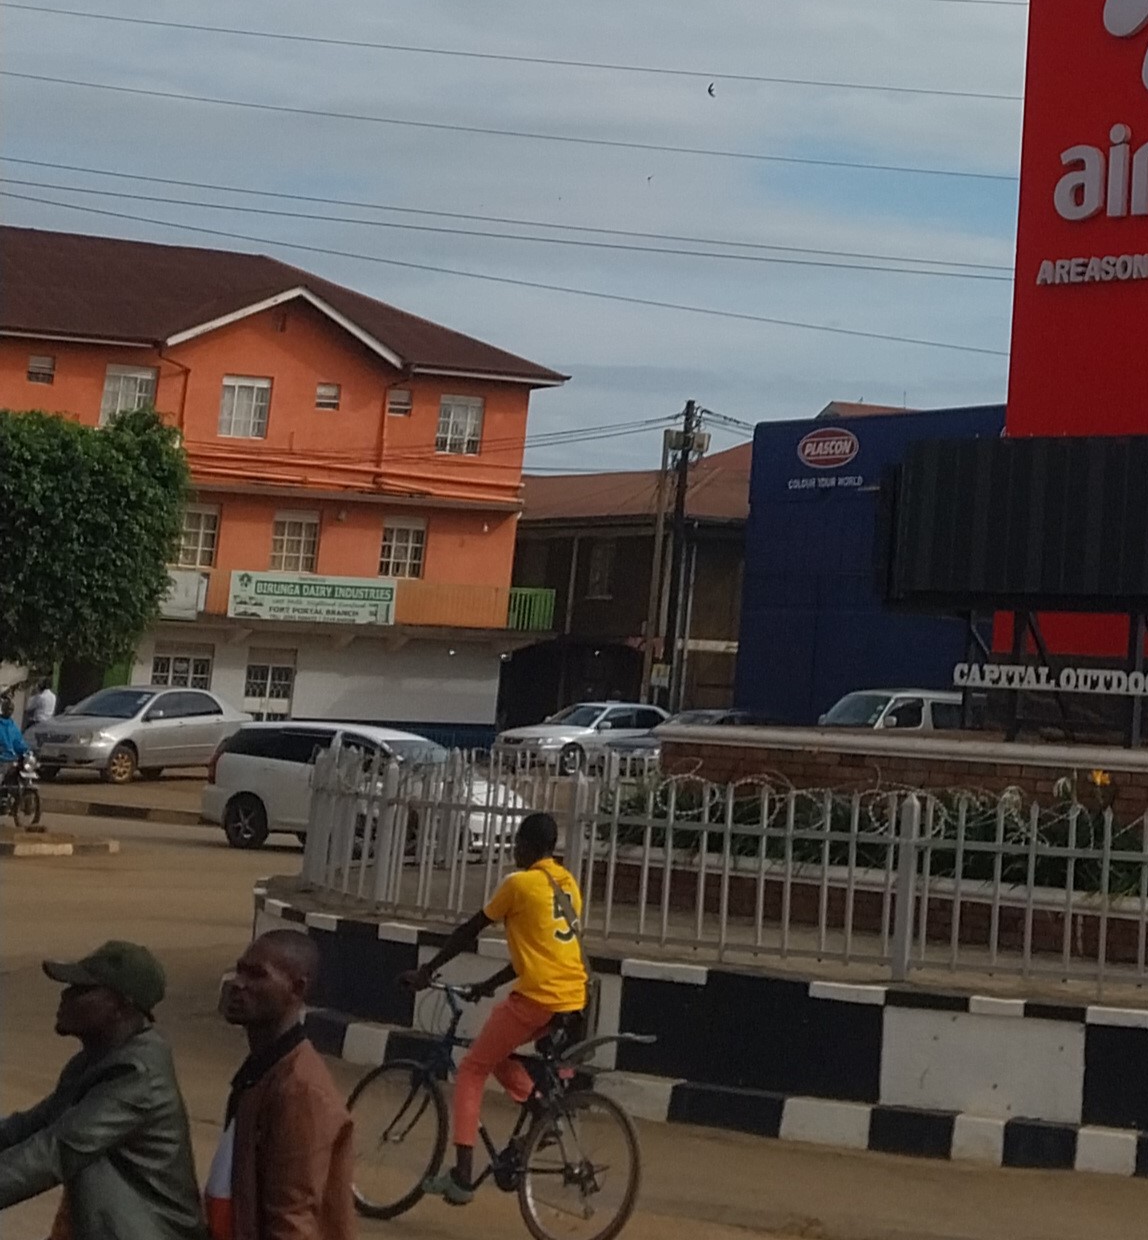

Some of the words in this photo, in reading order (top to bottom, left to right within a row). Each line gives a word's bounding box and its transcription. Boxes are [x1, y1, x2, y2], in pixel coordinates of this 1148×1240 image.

[804, 439, 852, 457] PLASCON
[787, 477, 816, 490] COLOUR
[817, 477, 836, 488] YOUR
[837, 475, 863, 487] WORLD
[256, 582, 300, 596] BIRUNGA
[302, 585, 332, 599] DAIRY
[334, 587, 392, 601] INDUSTRIES
[953, 662, 1056, 690] CAPITAL
